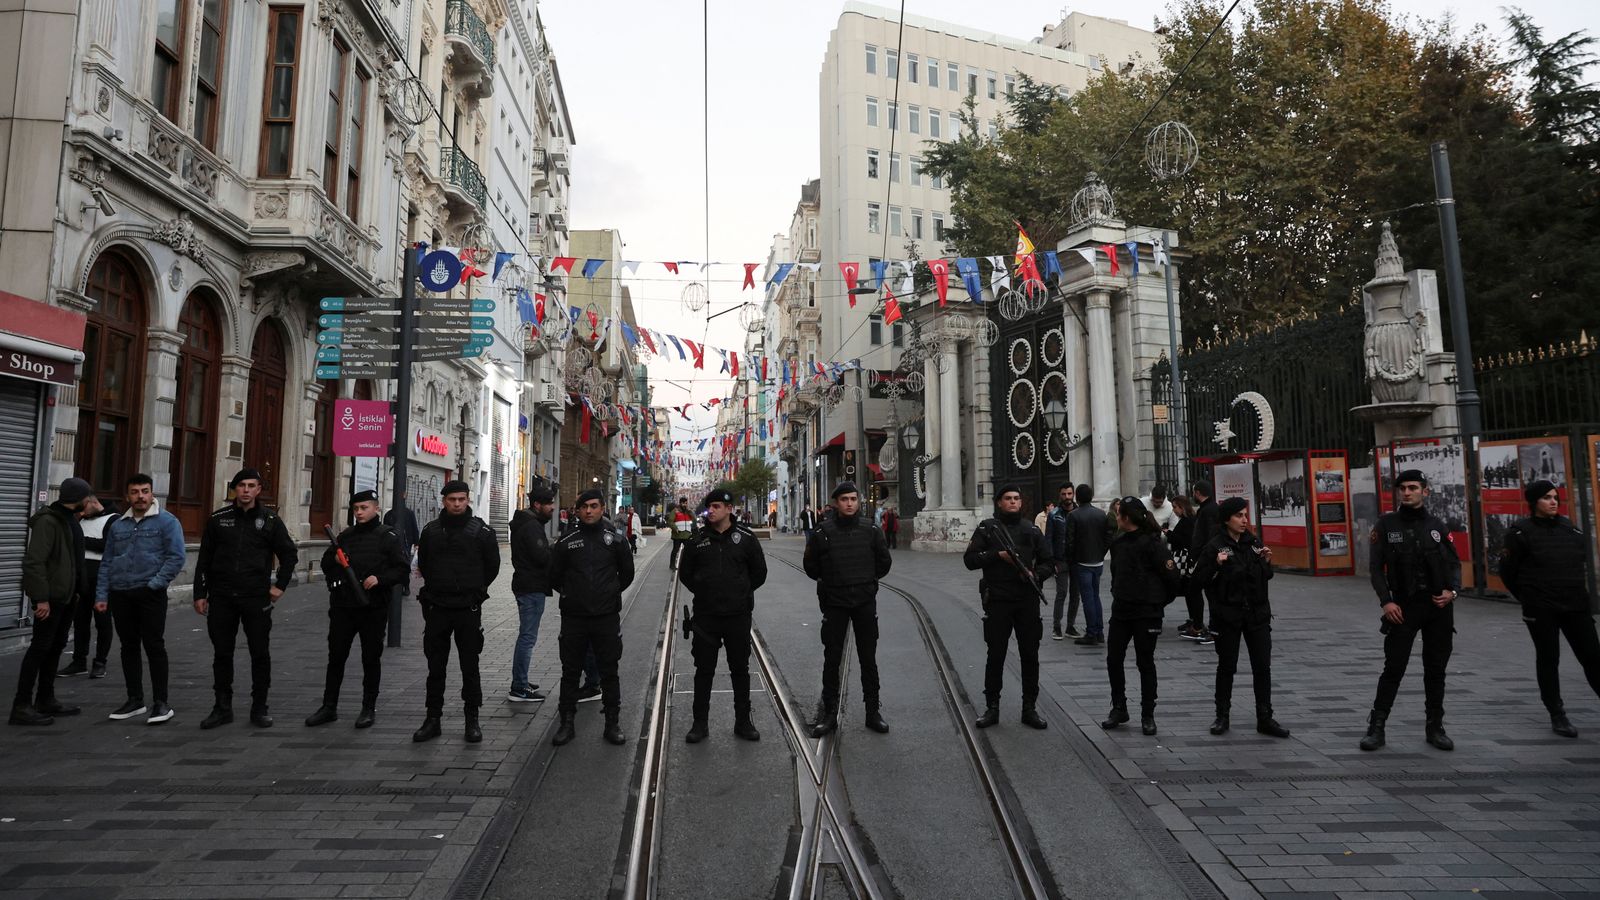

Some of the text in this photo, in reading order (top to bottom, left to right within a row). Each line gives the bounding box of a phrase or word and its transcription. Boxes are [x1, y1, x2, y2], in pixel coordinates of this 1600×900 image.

[9, 353, 55, 380] Shop
[358, 412, 386, 423] İstiklal
[358, 423, 382, 431] Senin
[422, 435, 449, 457] vodafone
